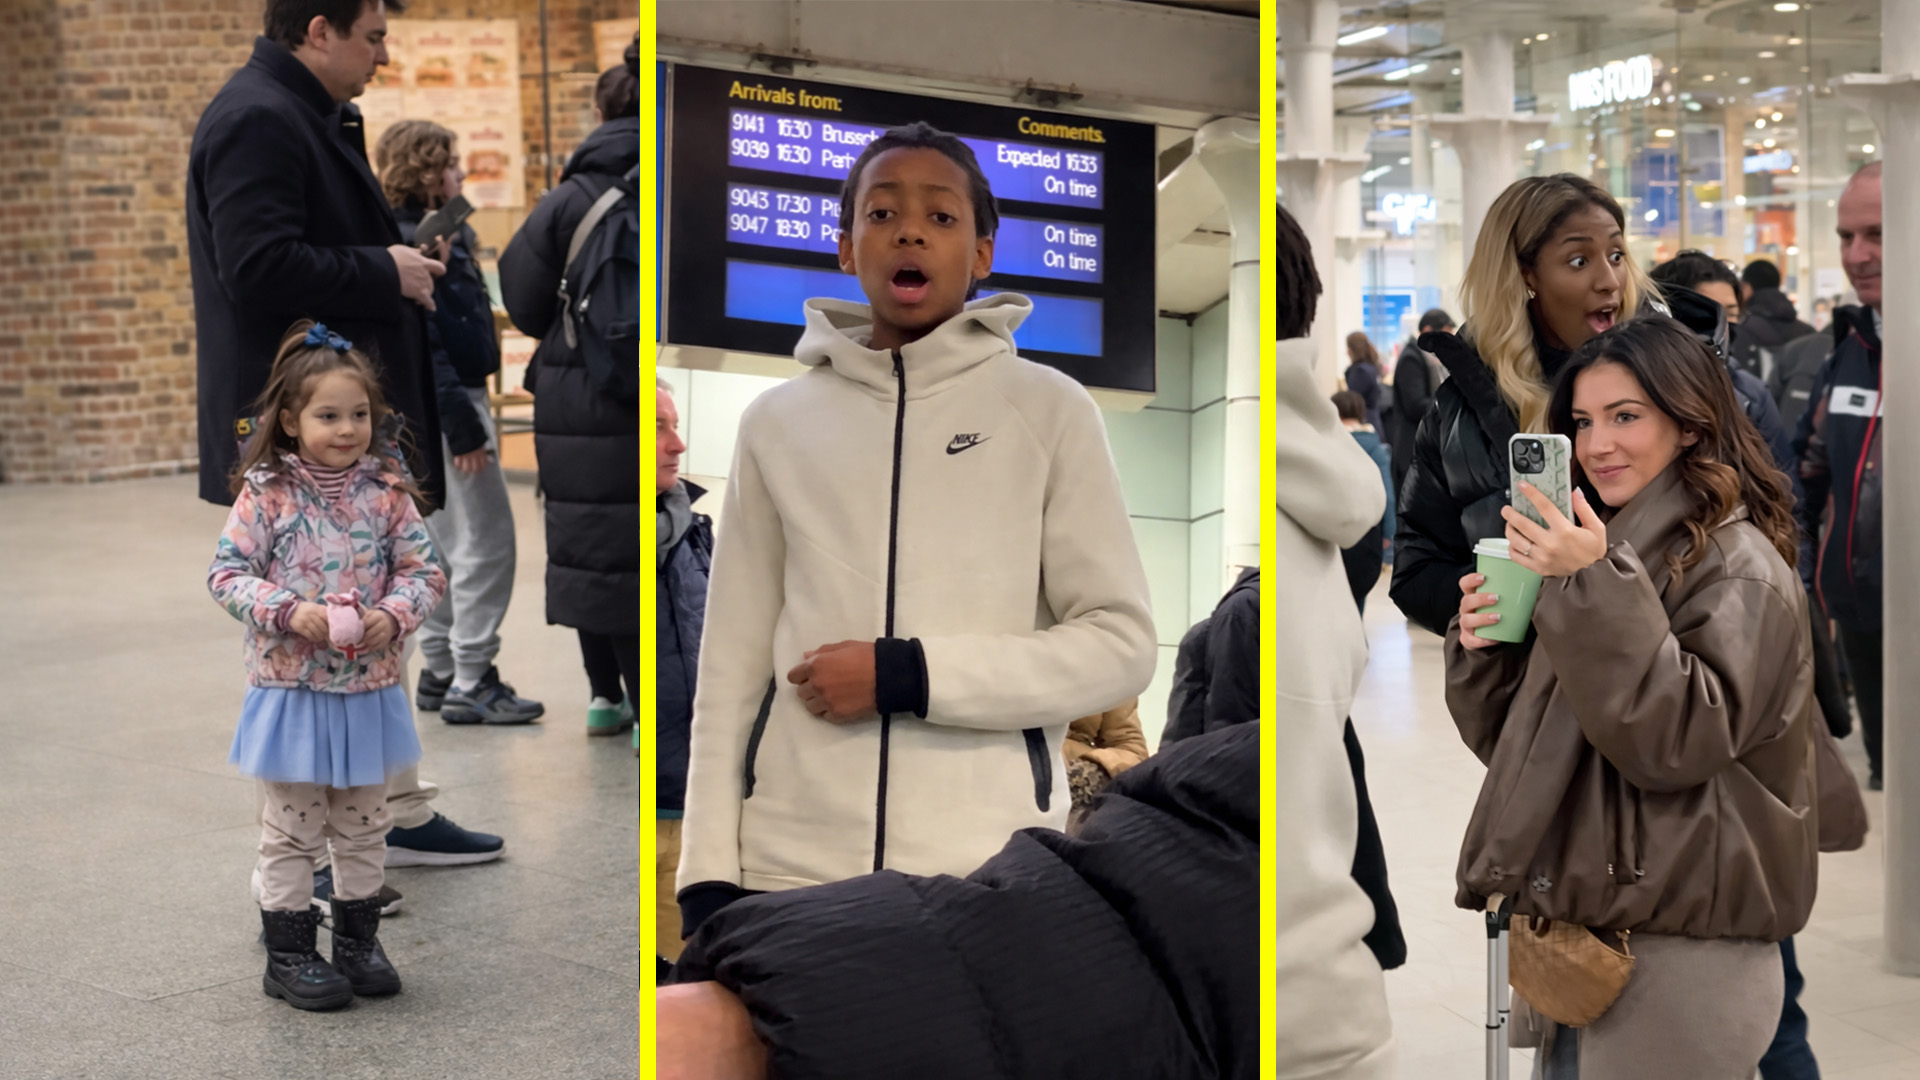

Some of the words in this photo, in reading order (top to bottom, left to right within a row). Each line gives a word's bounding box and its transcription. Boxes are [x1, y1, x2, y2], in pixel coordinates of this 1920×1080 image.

[728, 80, 796, 105] Arrivals
[799, 89, 843, 112] from:
[732, 113, 765, 134] 9141
[731, 138, 770, 159] 9039
[997, 144, 1060, 169] Expected
[1044, 175, 1065, 194] On
[1069, 178, 1097, 198] time
[730, 188, 770, 210] 9043
[730, 213, 769, 234] 9047
[1043, 225, 1065, 244] On
[1069, 227, 1097, 248] time
[1043, 249, 1065, 269] On
[1069, 252, 1097, 272] time
[951, 432, 981, 444] NIKE
